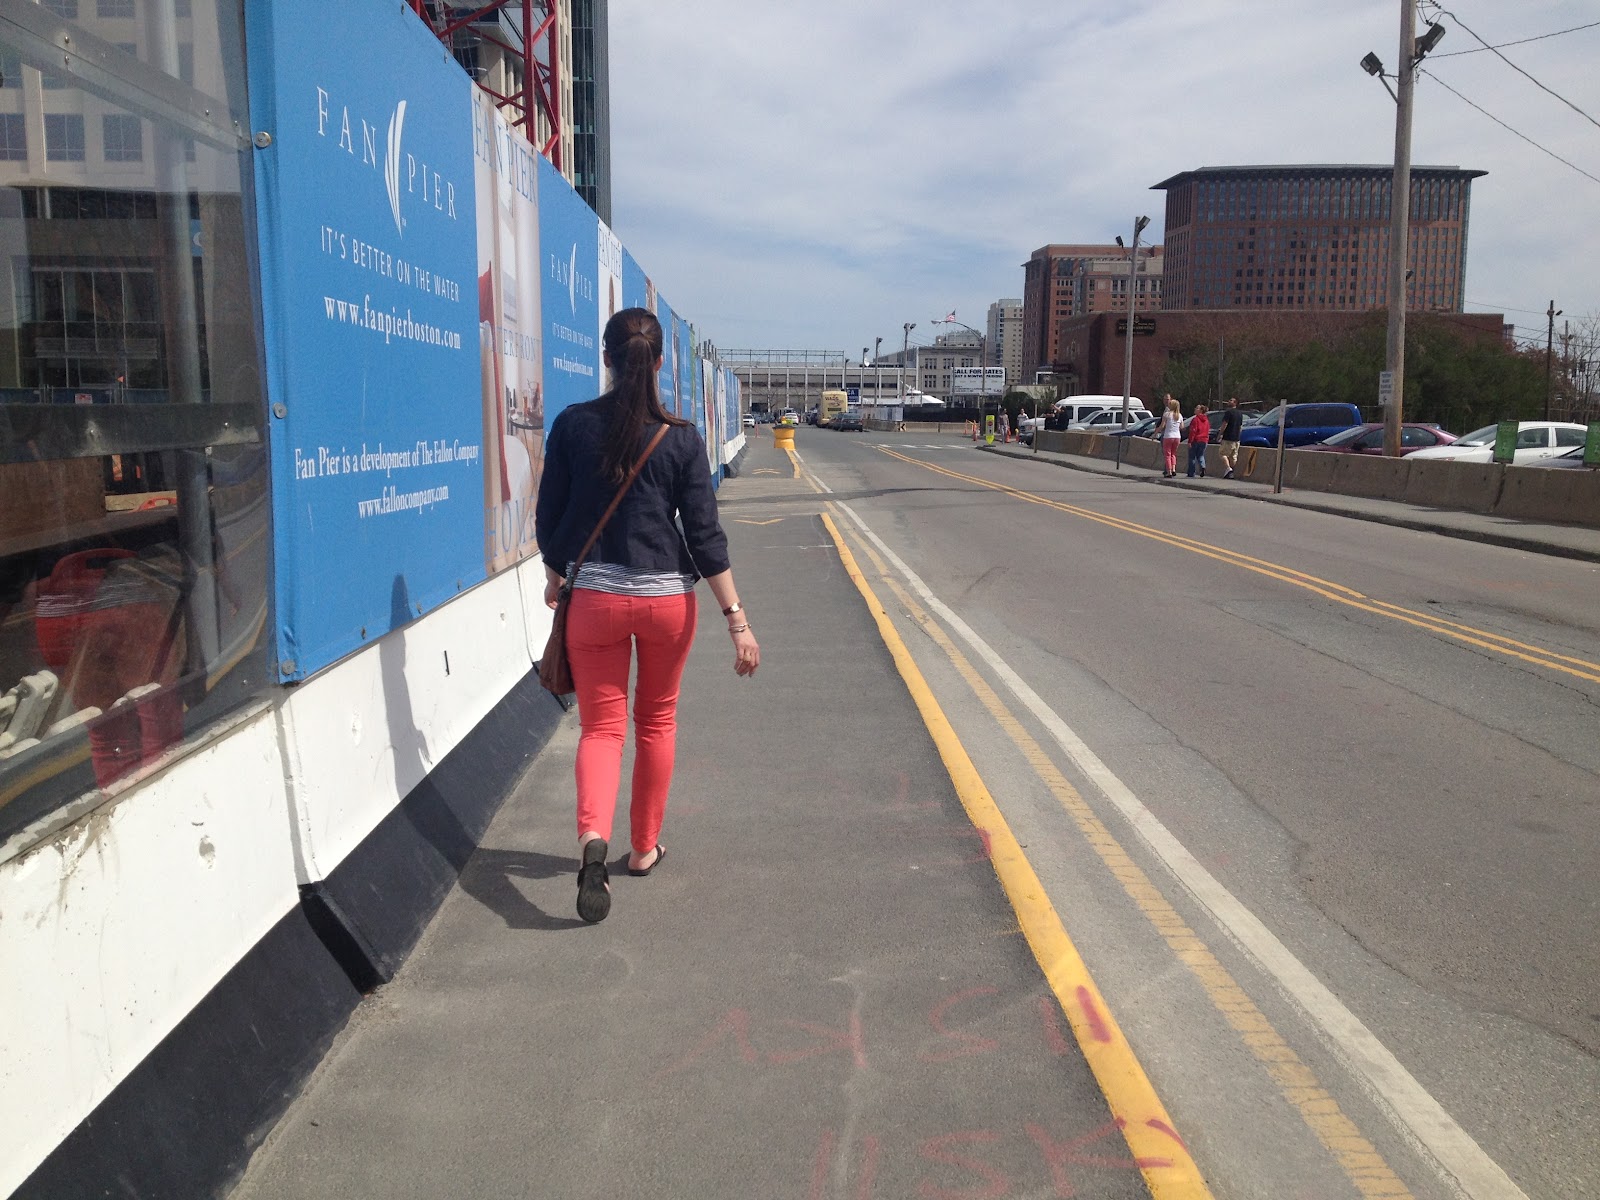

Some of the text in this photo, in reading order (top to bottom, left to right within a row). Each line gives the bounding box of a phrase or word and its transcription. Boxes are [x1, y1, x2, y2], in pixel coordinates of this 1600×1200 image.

[316, 86, 457, 220] FAN PIER
[474, 98, 504, 177] FAN
[321, 225, 460, 303] IT'S BETTER ON THE WATER
[551, 254, 593, 302] FAN PIER
[323, 294, 461, 349] www.fanpierboston.com
[294, 439, 480, 480] Fan Pier is a development of The Fallon Company
[357, 484, 449, 519] www.falloncompany.com
